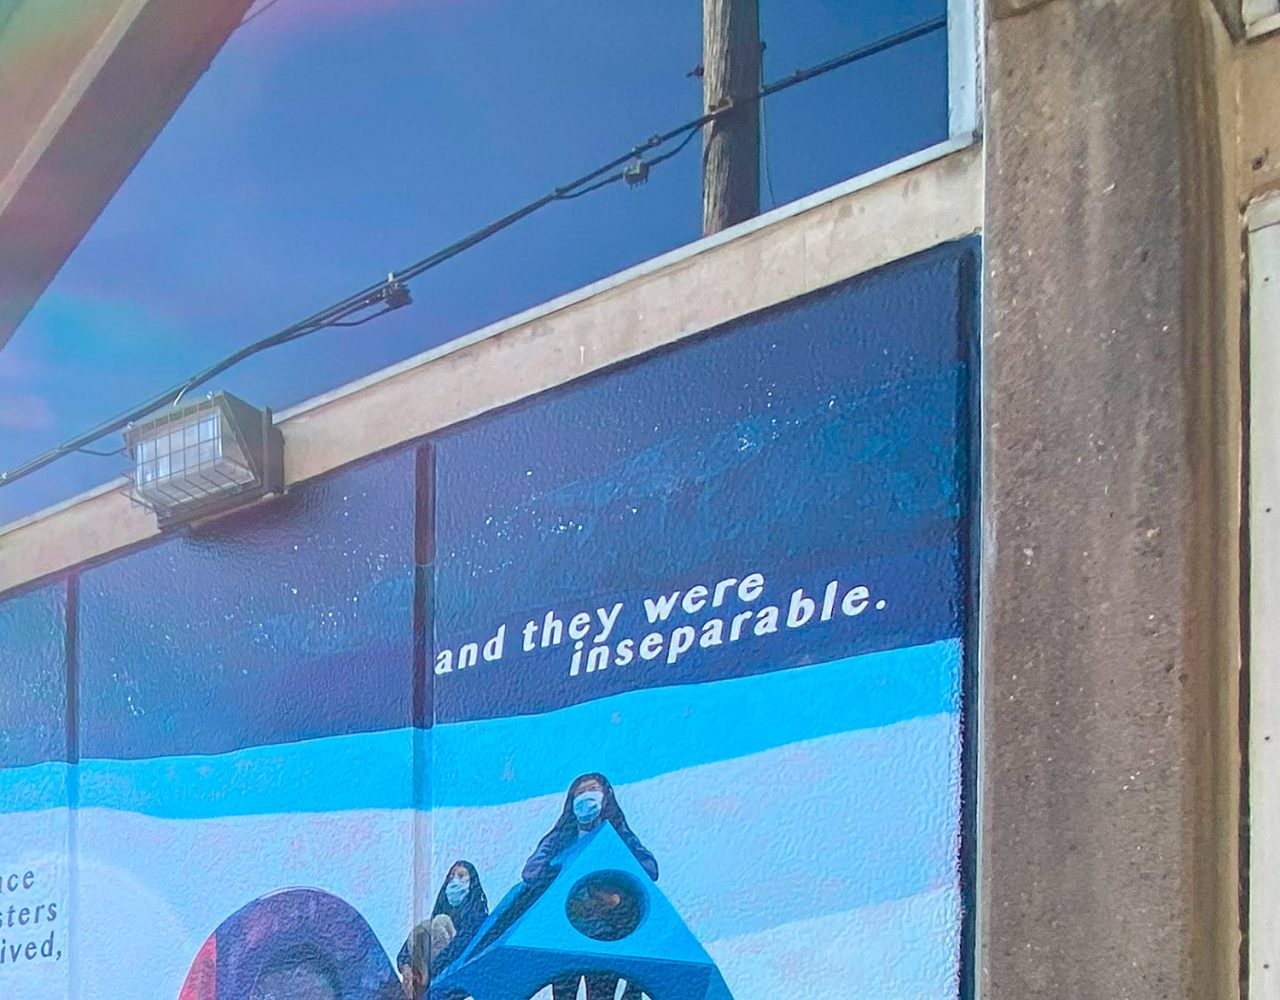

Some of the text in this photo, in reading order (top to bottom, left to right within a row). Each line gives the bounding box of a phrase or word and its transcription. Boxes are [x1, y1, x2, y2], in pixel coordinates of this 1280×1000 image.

[434, 572, 765, 675] and they were
[568, 580, 887, 677] inseparable.
